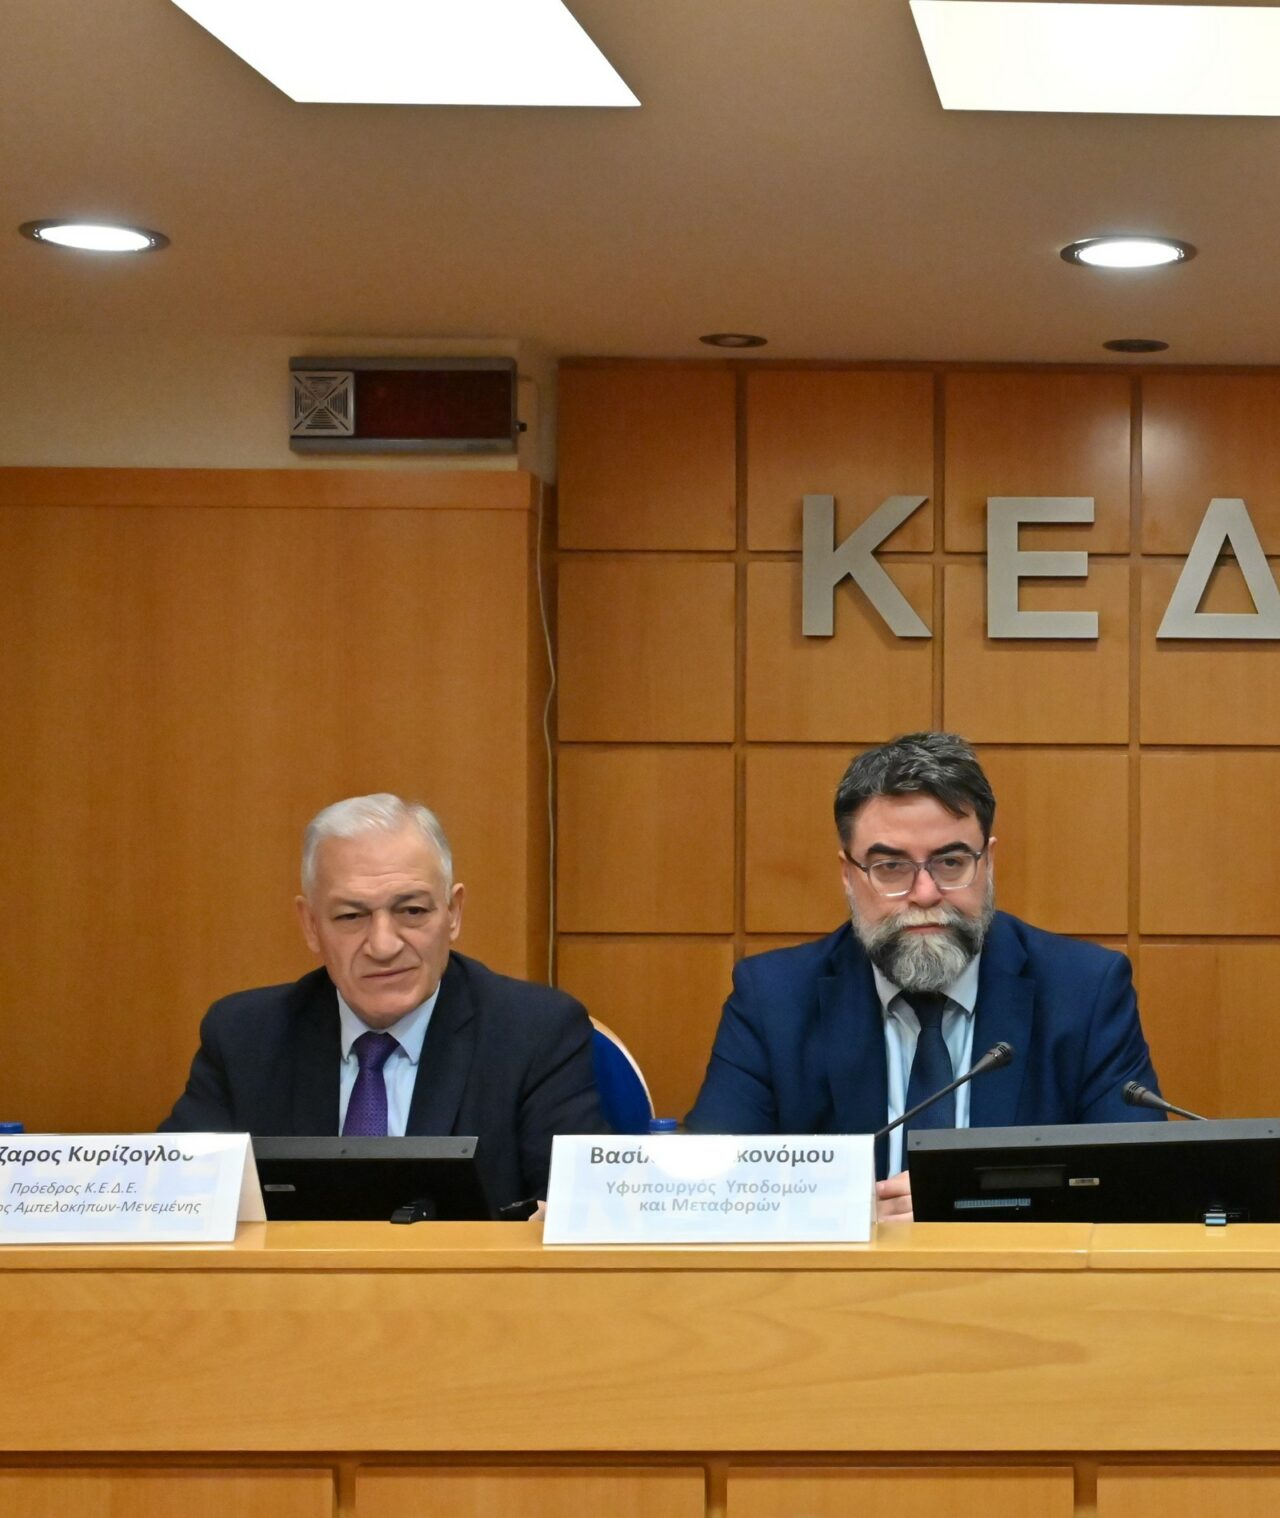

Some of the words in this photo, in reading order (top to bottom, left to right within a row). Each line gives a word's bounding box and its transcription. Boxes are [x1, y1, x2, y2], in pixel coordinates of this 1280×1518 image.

[0, 1146, 62, 1166] ζαρος
[590, 1145, 654, 1165] Βασί
[736, 1145, 834, 1167] κονόμου
[10, 1182, 81, 1196] Πρόεδρος
[84, 1182, 136, 1193] Κ.Ε.Δ.Ε.
[606, 1180, 716, 1197] Υφυπουργός
[726, 1179, 817, 1197] Υποδομών
[14, 1200, 201, 1215] Αμπελοκήπων-Μενεμένης
[640, 1201, 666, 1211] και
[672, 1198, 780, 1214] Μεταφορών
